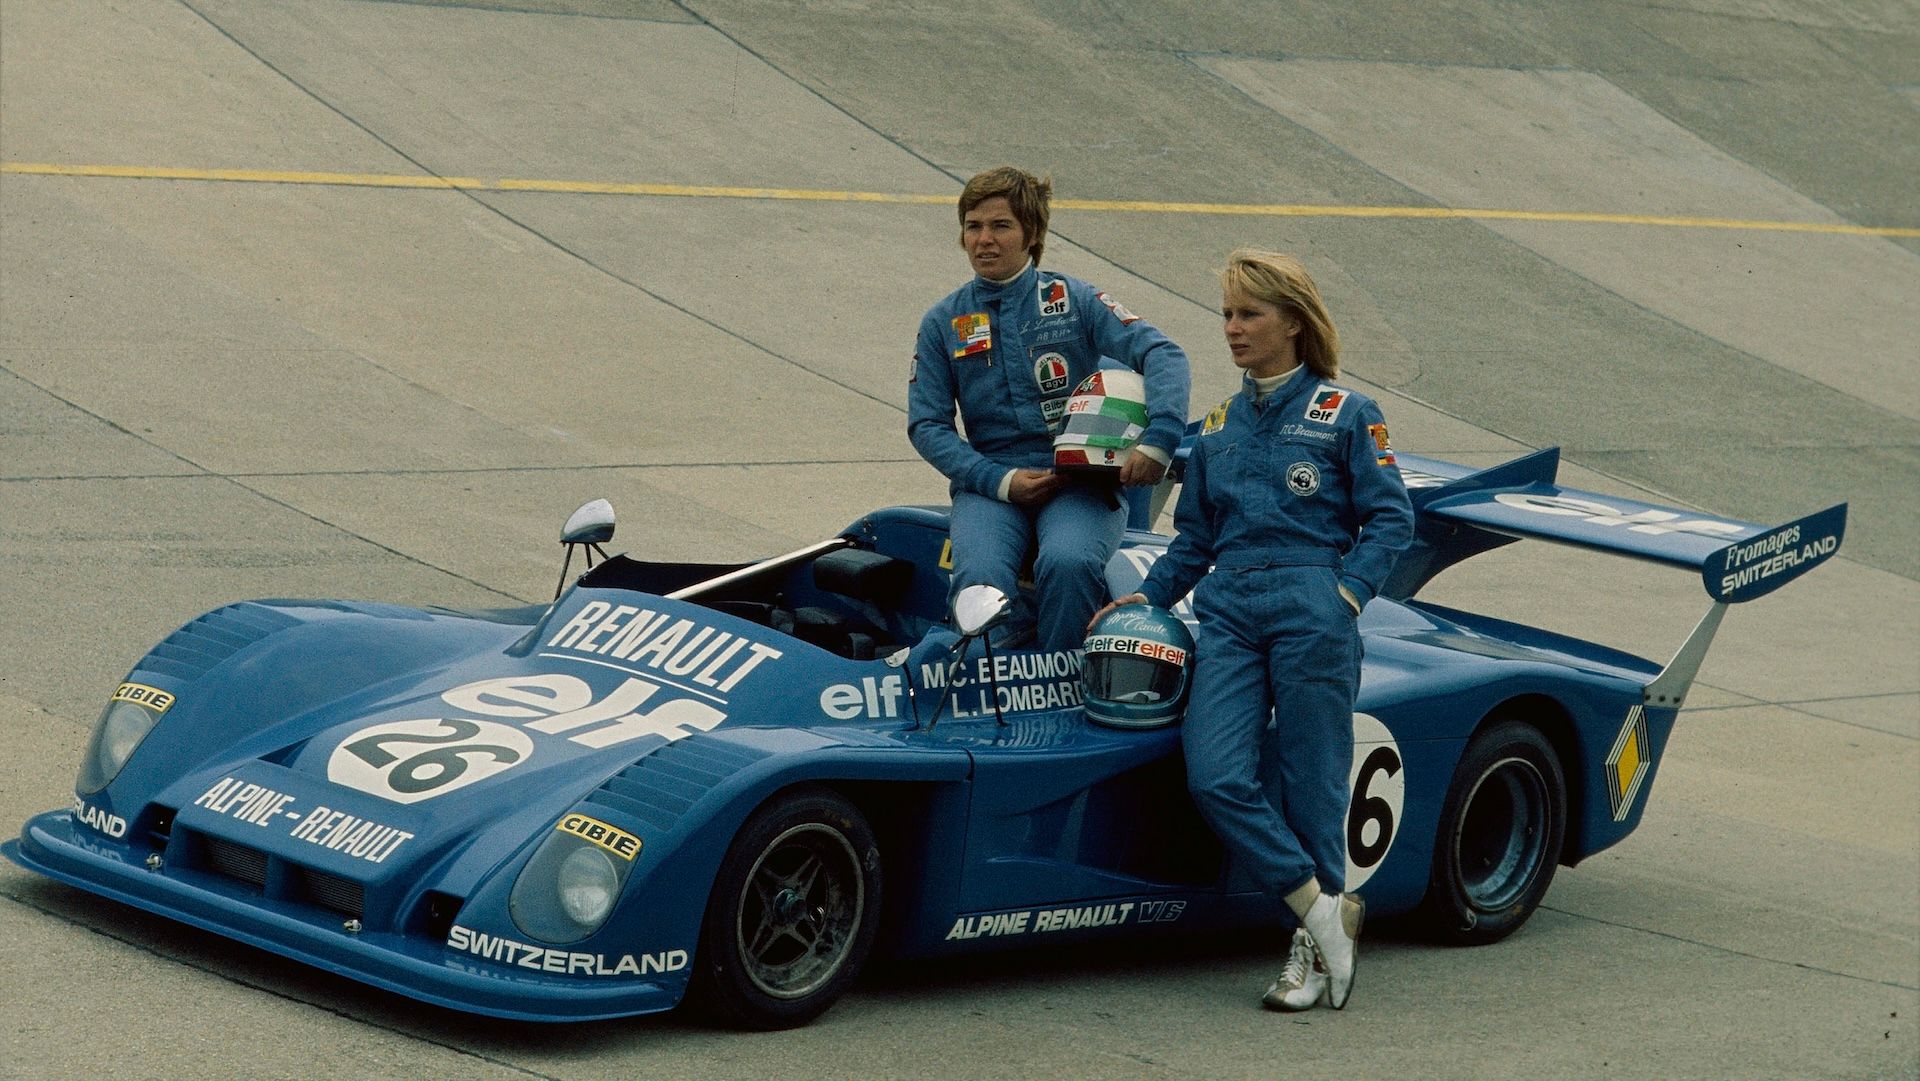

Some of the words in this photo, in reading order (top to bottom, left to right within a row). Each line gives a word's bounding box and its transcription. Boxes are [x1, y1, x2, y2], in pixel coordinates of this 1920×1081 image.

[1044, 301, 1066, 315] elf
[1045, 378, 1065, 390] agv
[1069, 400, 1089, 412] elf
[1309, 409, 1333, 421] elf
[1494, 493, 1746, 536] elf
[1721, 535, 1837, 595] SWITZERLAND
[1725, 525, 1801, 571] Fromages
[547, 600, 783, 693] RENAULT
[1094, 638, 1113, 651] elf
[1114, 639, 1139, 653] elf
[1140, 643, 1165, 658] elf
[1166, 648, 1184, 664] elf
[441, 674, 728, 749] elf
[820, 675, 902, 720] elf
[343, 719, 520, 793] 26
[945, 911, 1031, 941] ALPINE
[1032, 903, 1135, 934] RENAULT
[1138, 900, 1187, 924] V6
[447, 925, 688, 976] SWITZERLAND
